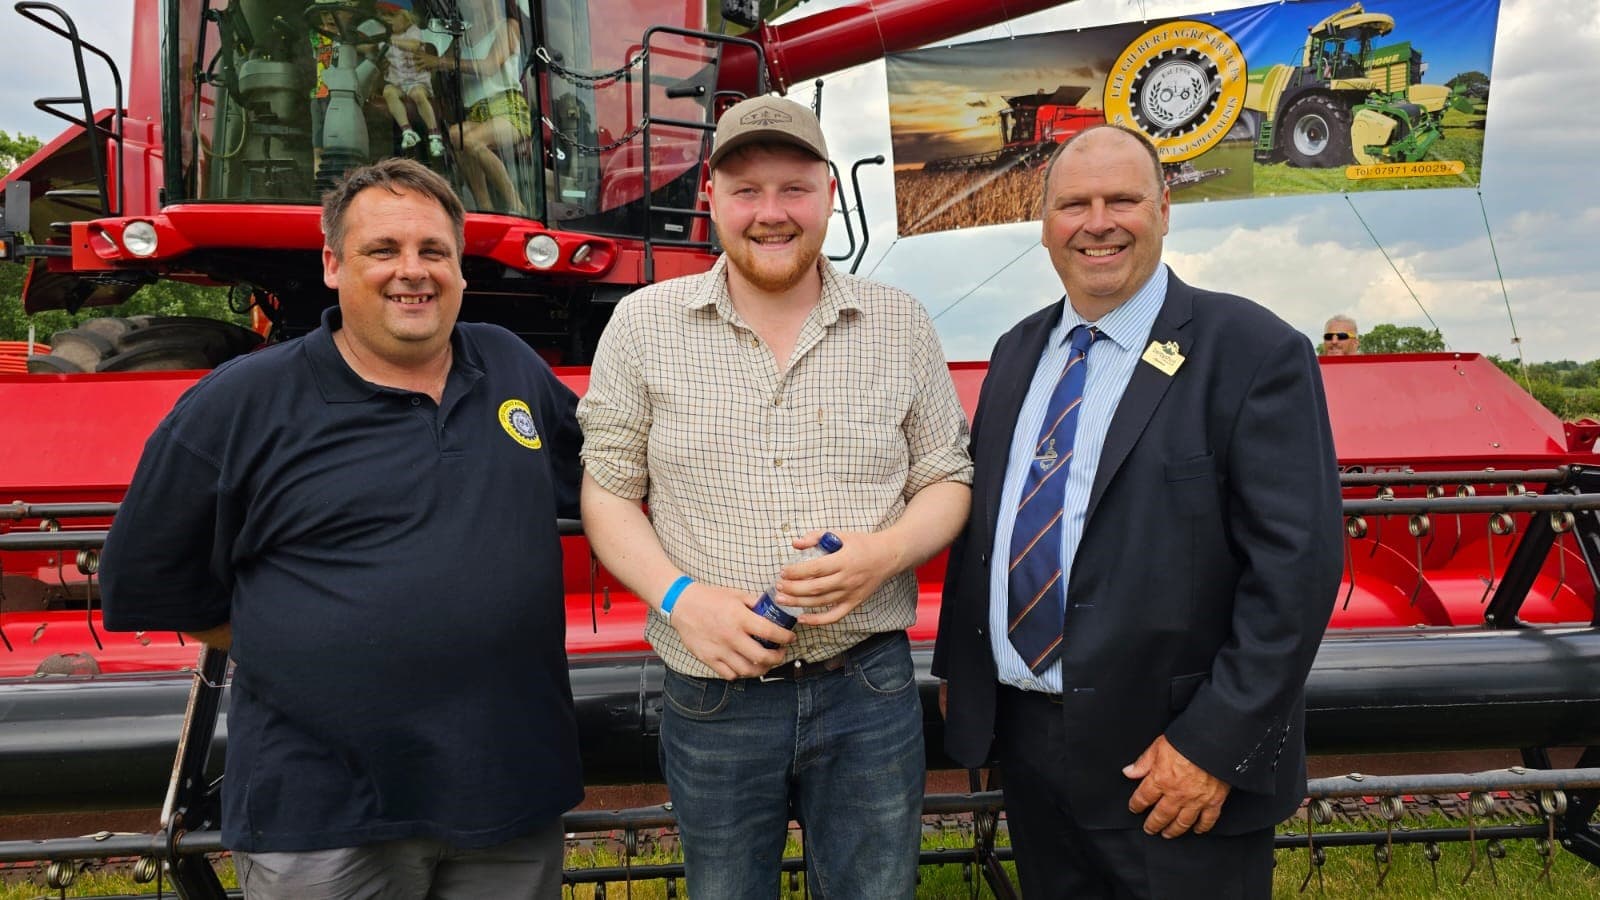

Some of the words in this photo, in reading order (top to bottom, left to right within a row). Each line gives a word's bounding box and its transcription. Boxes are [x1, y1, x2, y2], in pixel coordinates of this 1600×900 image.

[1111, 74, 1125, 98] LEE
[1121, 31, 1168, 72] GILBERT
[1173, 28, 1240, 82] AGRISERVICES
[1158, 144, 1189, 155] RVEST
[1191, 96, 1237, 149] SPECIALISTS
[1374, 166, 1407, 175] 07971
